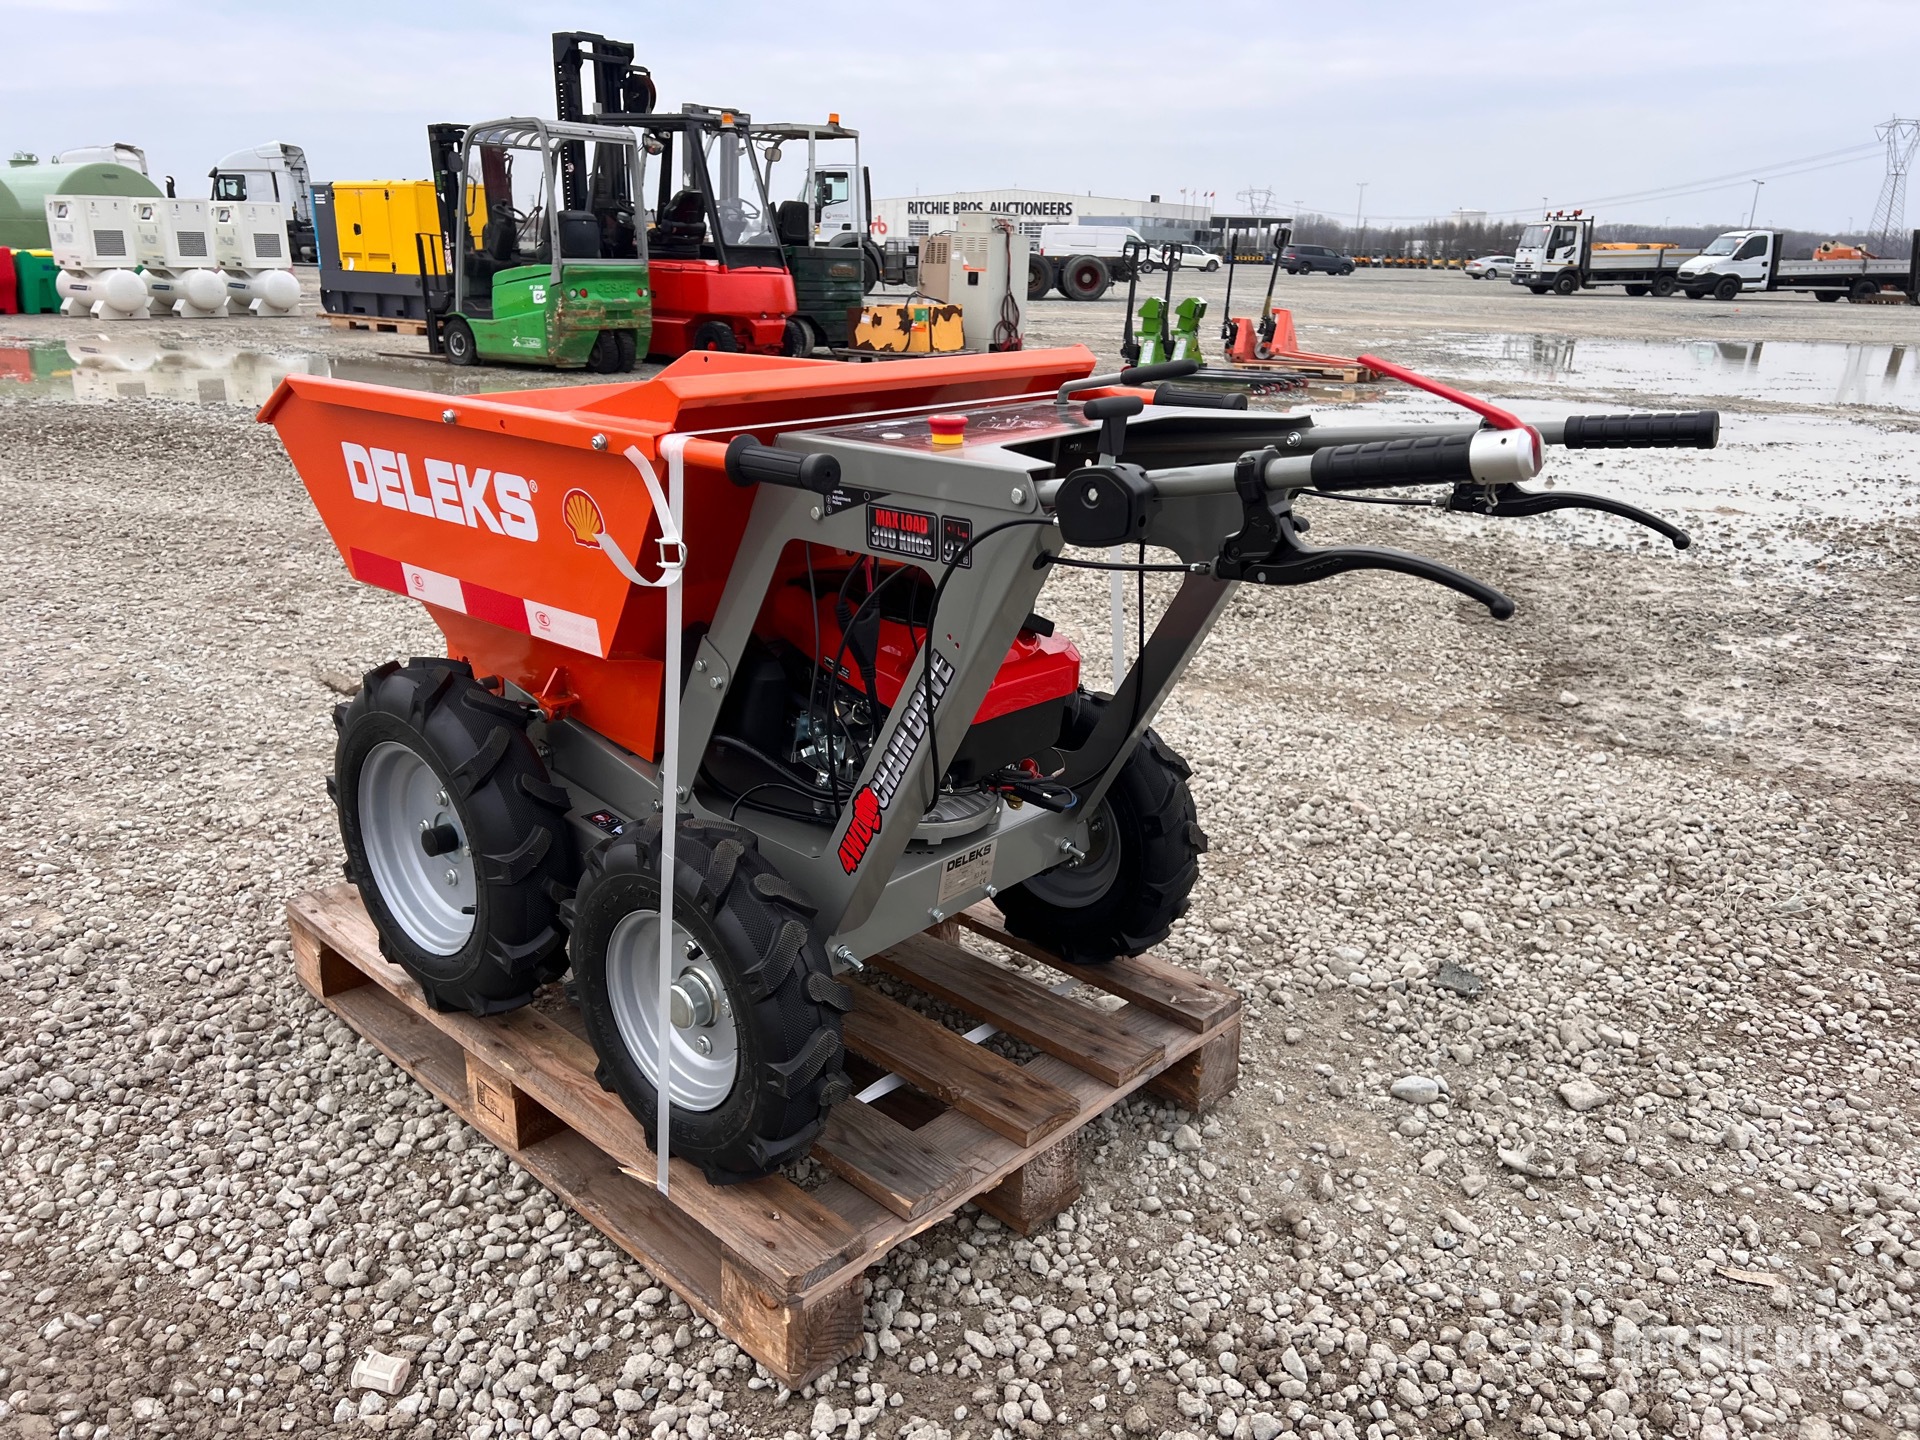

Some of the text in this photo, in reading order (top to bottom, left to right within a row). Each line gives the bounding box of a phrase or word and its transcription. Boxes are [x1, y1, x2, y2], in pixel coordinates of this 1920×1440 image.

[907, 201, 950, 215] RITCHIE
[989, 201, 1073, 216] AUCTIONEERS
[875, 508, 928, 535] MAX LOAD
[871, 526, 932, 556] 300 kilos
[944, 539, 965, 562] 97
[838, 649, 955, 875] 4WD CHAIN DRIVE
[946, 843, 992, 873] DELEKS
